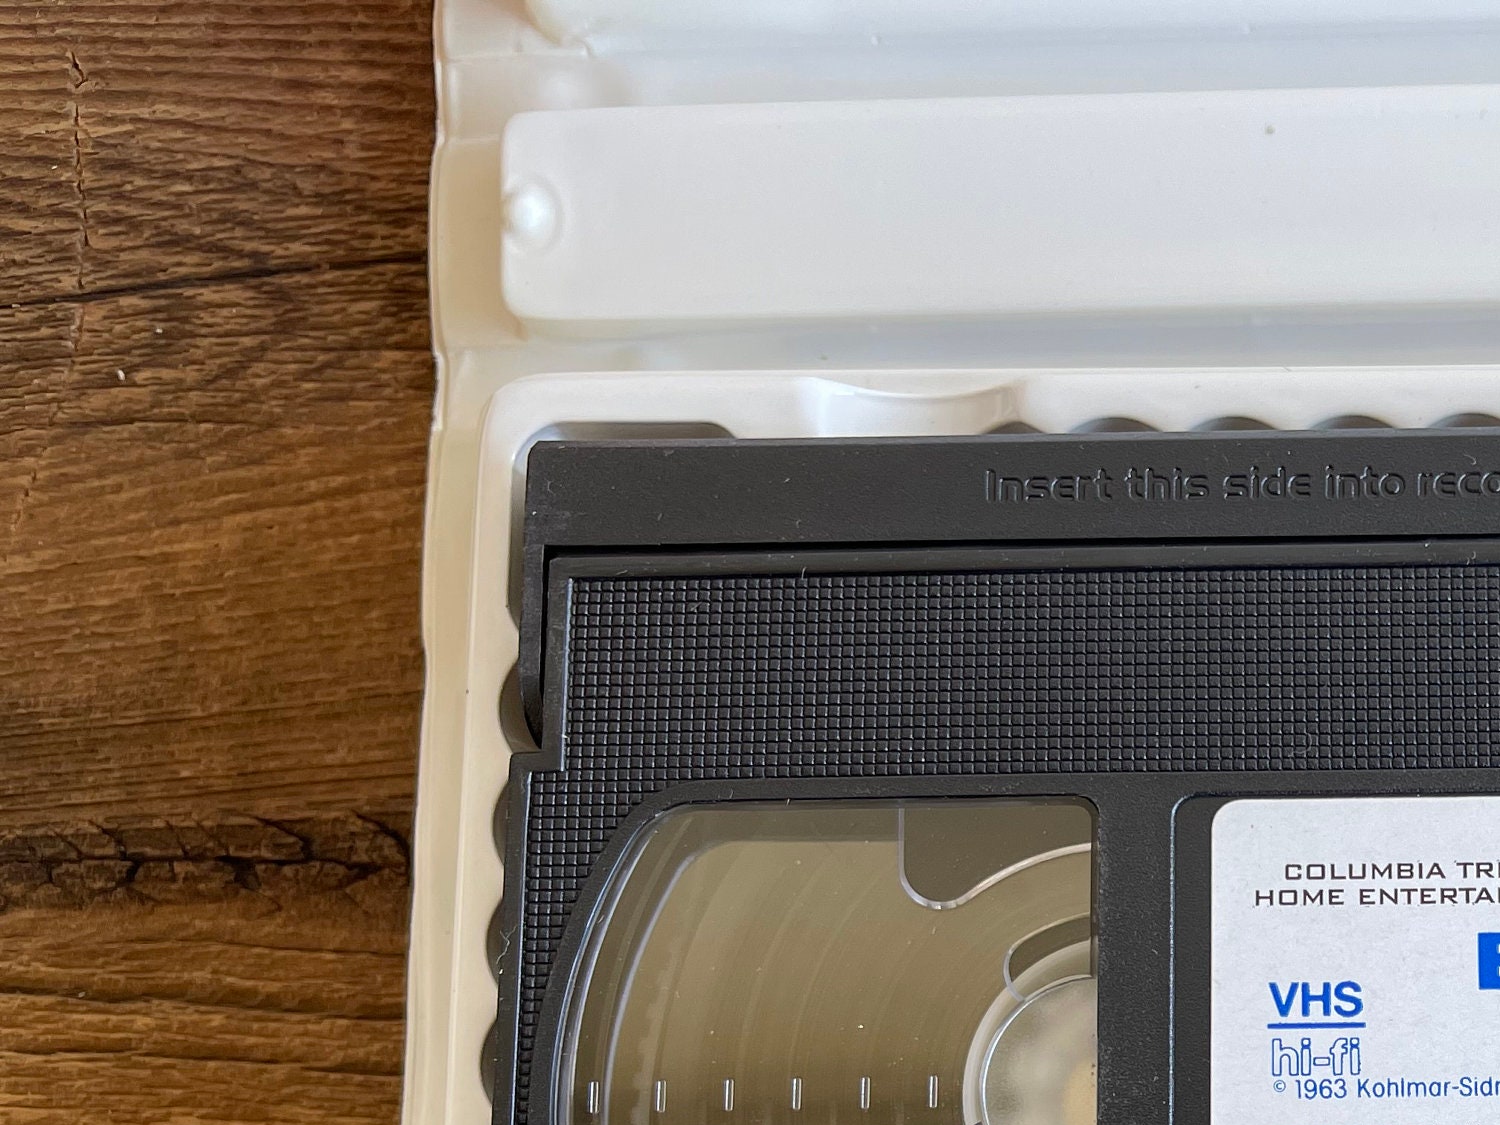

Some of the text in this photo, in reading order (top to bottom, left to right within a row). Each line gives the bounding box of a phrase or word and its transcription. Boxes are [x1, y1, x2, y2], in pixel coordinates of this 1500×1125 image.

[984, 467, 1113, 501] Insert
[1124, 466, 1209, 501] this
[1222, 465, 1312, 500] side
[1325, 464, 1406, 500] into
[1285, 862, 1446, 880] COLUMBIA
[1254, 889, 1344, 908] HOME
[1268, 980, 1363, 1018] VHS
[1272, 1037, 1361, 1077] hi-fi
[1295, 1078, 1347, 1100] 1963
